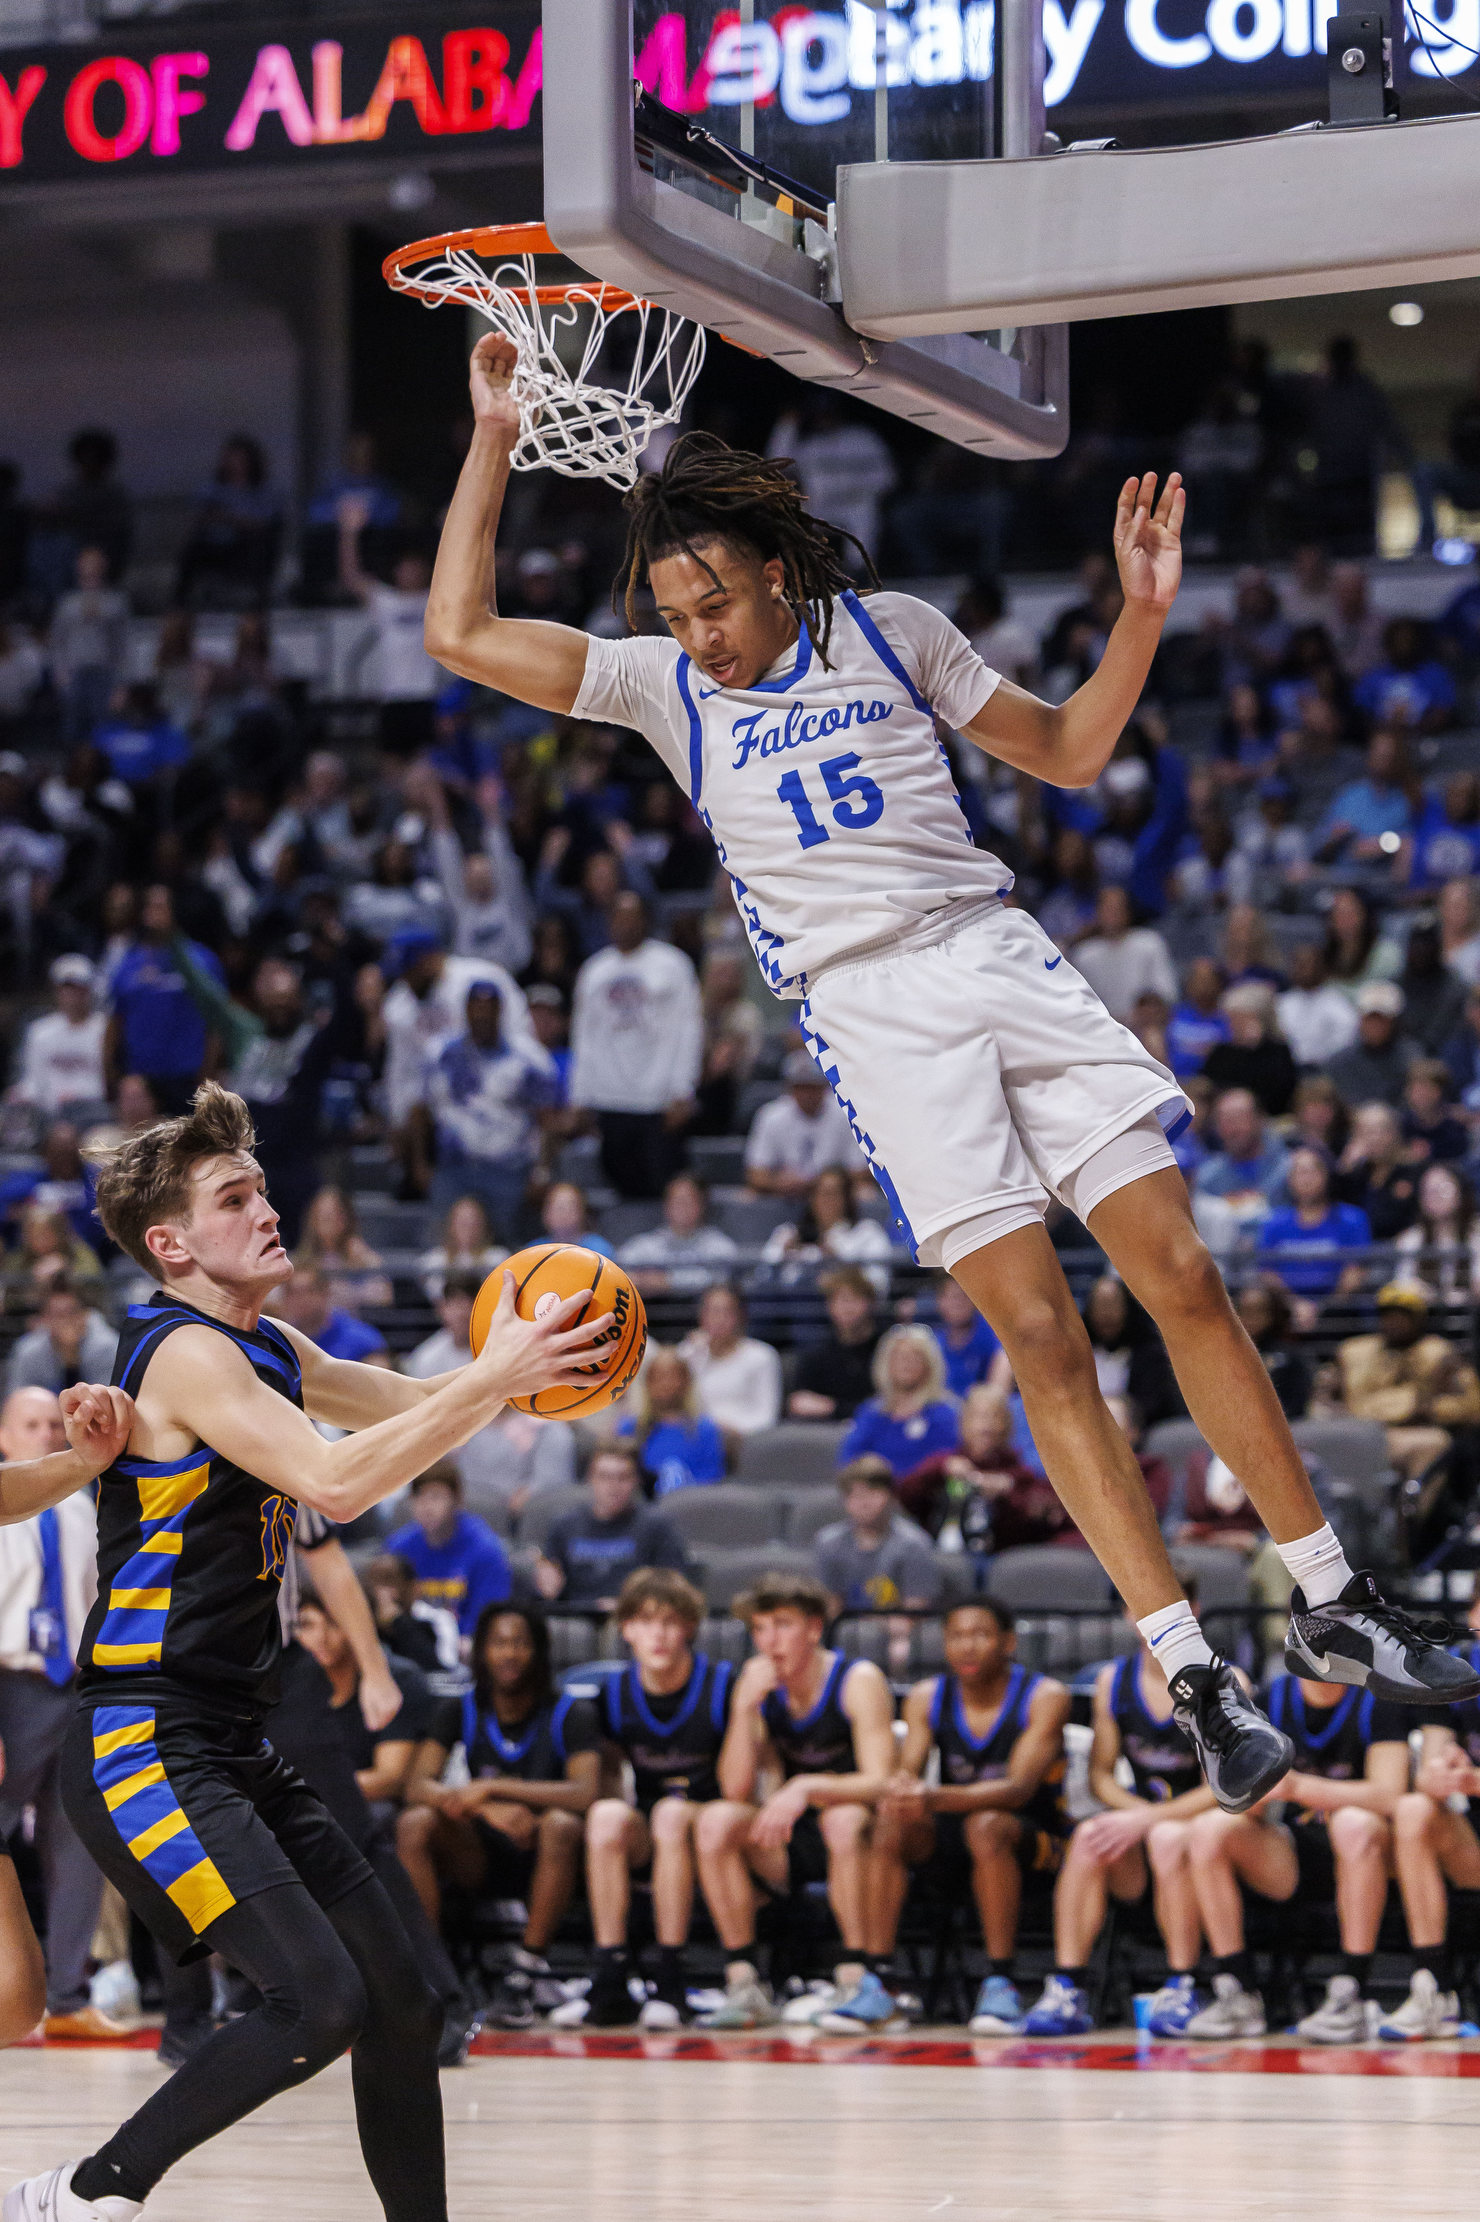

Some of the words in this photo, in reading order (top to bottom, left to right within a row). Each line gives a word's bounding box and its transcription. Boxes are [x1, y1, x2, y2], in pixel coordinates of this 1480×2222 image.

[64, 52, 209, 163] OF
[731, 699, 894, 770] Falcons
[776, 751, 885, 851] 15
[569, 1287, 630, 1391] son
